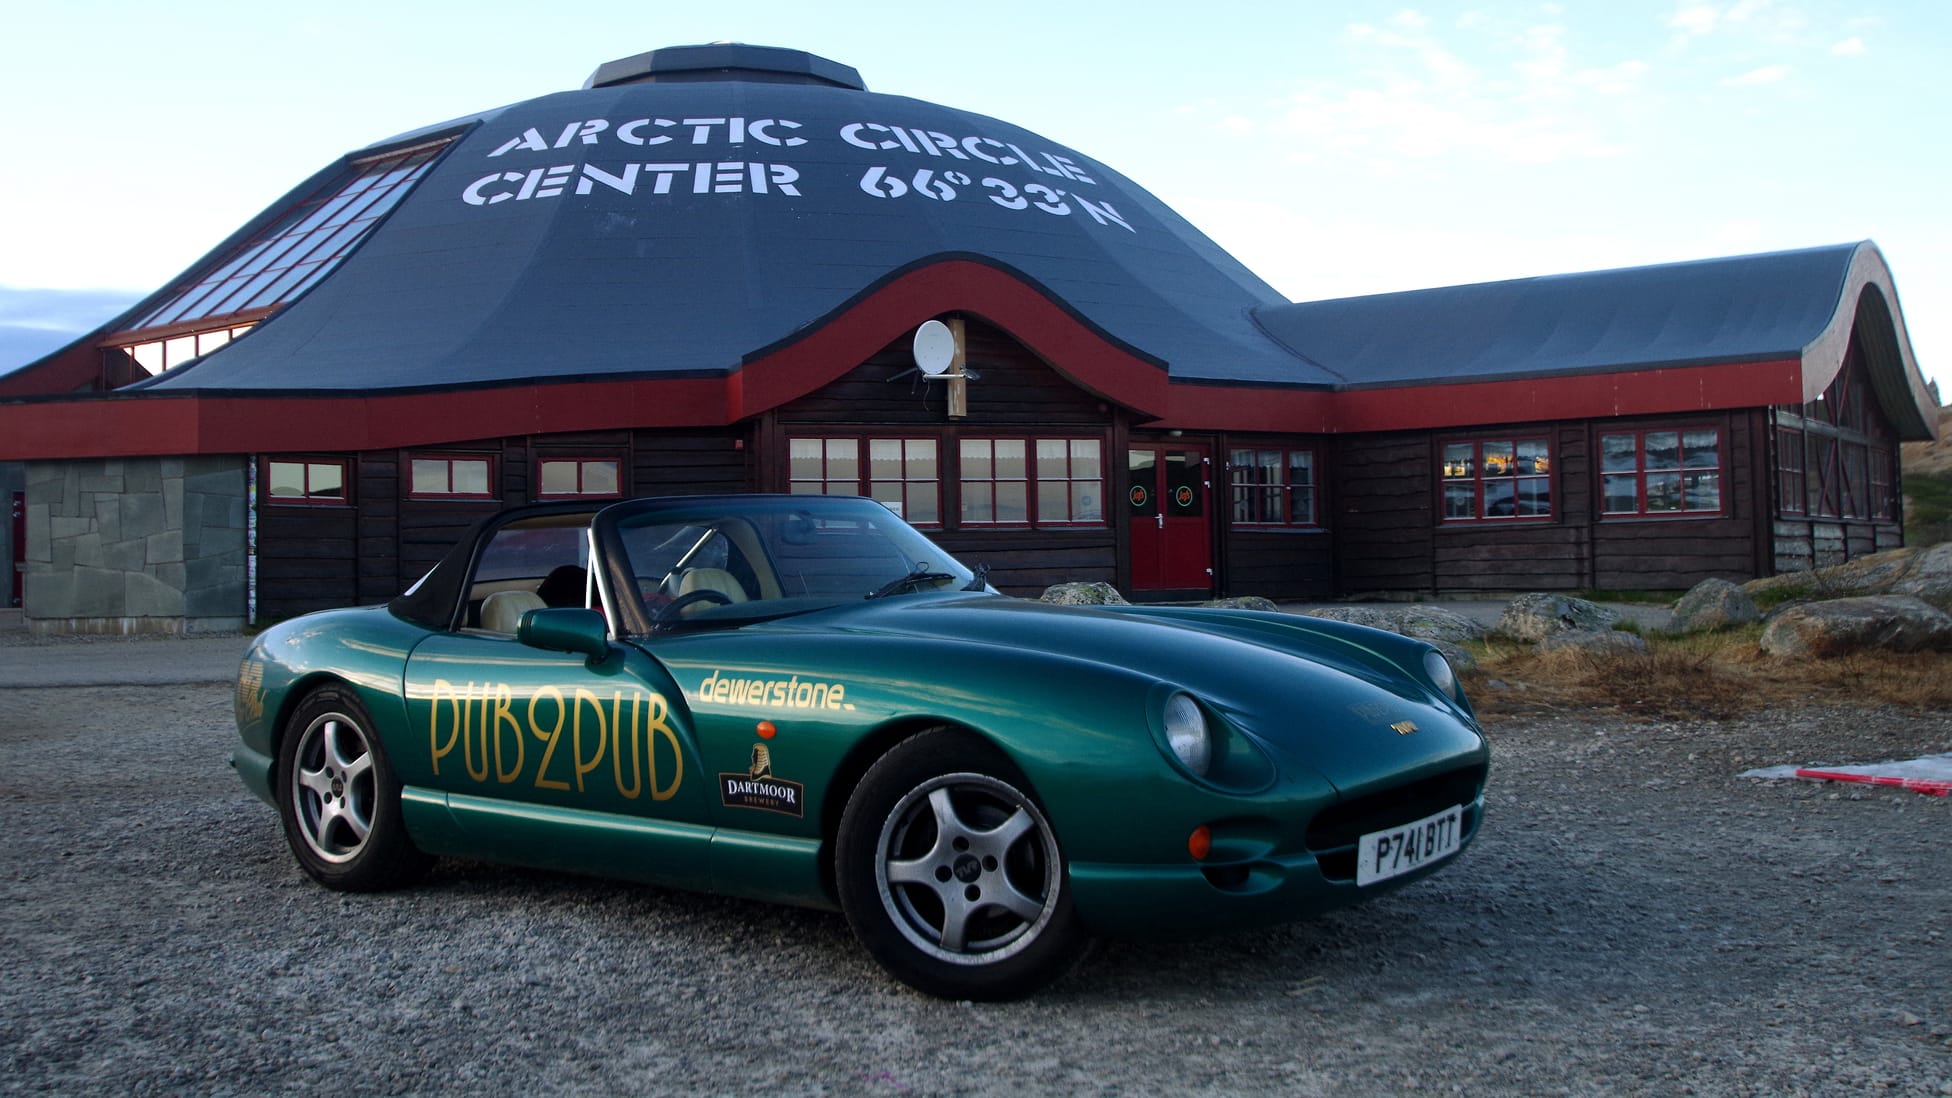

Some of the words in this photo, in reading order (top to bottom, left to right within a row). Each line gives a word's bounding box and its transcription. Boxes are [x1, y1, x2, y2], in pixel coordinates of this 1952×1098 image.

[487, 117, 808, 157] ARCTIC
[839, 122, 1097, 185] CIRCLE
[462, 161, 801, 206] CENTER
[430, 678, 683, 801] PUB2PUB
[727, 779, 796, 804] DARTMOOR
